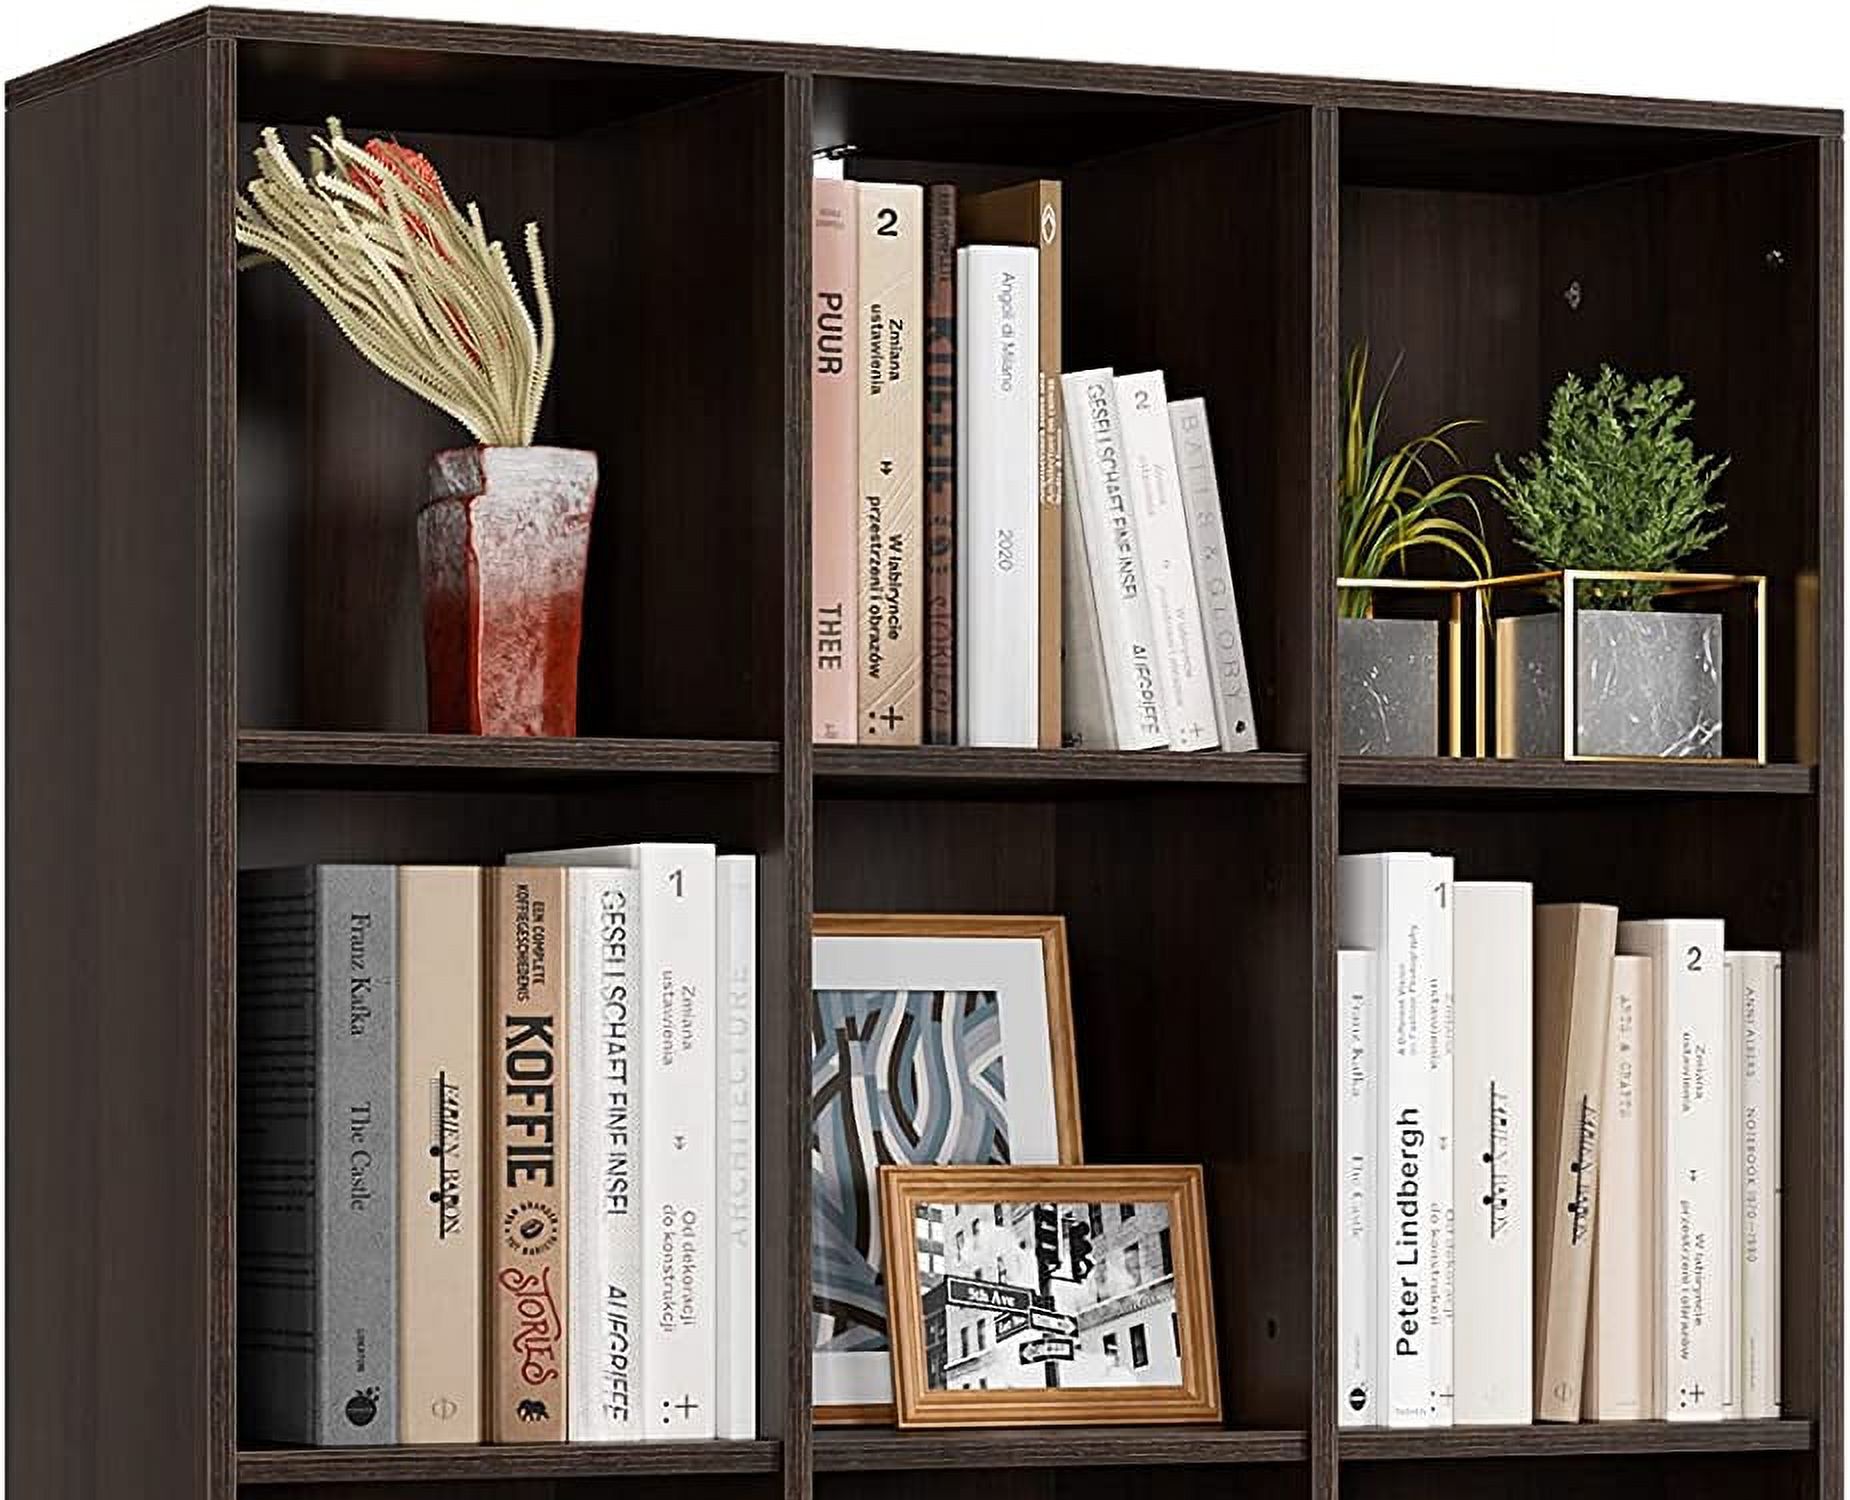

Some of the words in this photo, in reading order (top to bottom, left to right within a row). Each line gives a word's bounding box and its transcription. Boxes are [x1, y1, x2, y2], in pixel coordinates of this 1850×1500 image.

[877, 207, 898, 237] 2
[998, 272, 1016, 320] Angoli
[817, 291, 843, 375] PUUR
[870, 303, 885, 396] ustawienia
[889, 319, 904, 382] Zmiana
[1001, 323, 1016, 338] di
[1001, 341, 1016, 393] Milano
[866, 495, 883, 593] przestrzeni
[888, 533, 903, 553] W
[998, 528, 1014, 573] 2020
[884, 556, 903, 641] labiryncie
[818, 602, 842, 671] THEE
[868, 603, 884, 679] obrazów
[669, 869, 683, 897] 1
[1434, 882, 1447, 909] 1
[351, 913, 372, 970] Franz
[532, 925, 546, 987] COMPLETE
[1686, 945, 1702, 972] 2
[351, 976, 372, 1036] Kafka
[662, 970, 677, 1066] ustawienia
[681, 984, 696, 1050] Zmiana
[351, 1101, 371, 1142] The
[505, 1015, 554, 1188] KOFFIE
[1744, 1107, 1757, 1185] NOTEBOOK
[350, 1150, 372, 1212] Castle
[1396, 1108, 1424, 1265] Lindbergh
[662, 1203, 676, 1226] do
[682, 1210, 697, 1238] Od
[660, 1231, 677, 1333] konstrukcji
[680, 1242, 697, 1326] dekoracji
[991, 1290, 1016, 1307] Ave
[500, 1265, 562, 1386] STORIES
[1396, 1276, 1420, 1356] Peter
